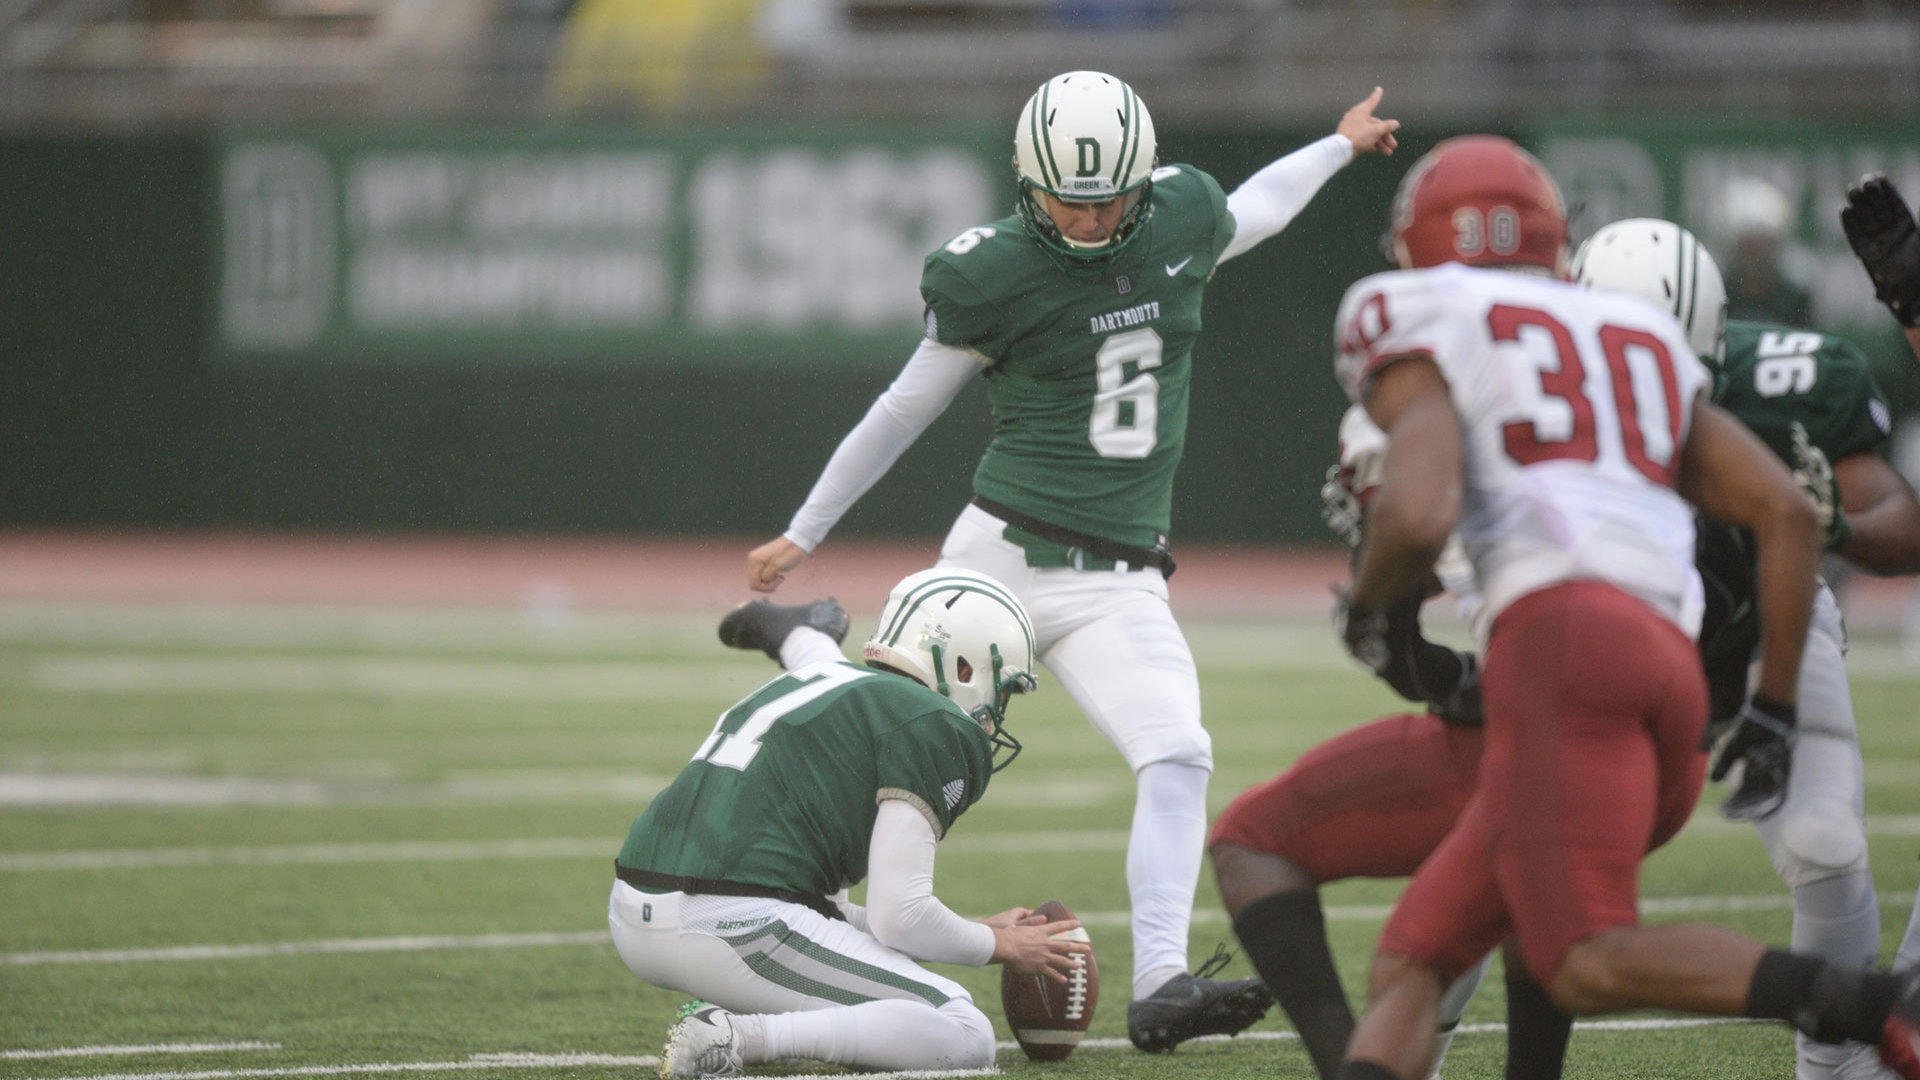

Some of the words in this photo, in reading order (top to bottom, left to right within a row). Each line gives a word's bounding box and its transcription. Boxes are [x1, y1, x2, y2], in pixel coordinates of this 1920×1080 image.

[1075, 137, 1101, 177] D
[1073, 181, 1100, 190] GREEN
[1451, 205, 1521, 257] 30
[1090, 301, 1161, 334] DARTMOUTH
[1754, 327, 1824, 399] 95
[1089, 326, 1164, 459] 6
[1487, 304, 1683, 488] 30
